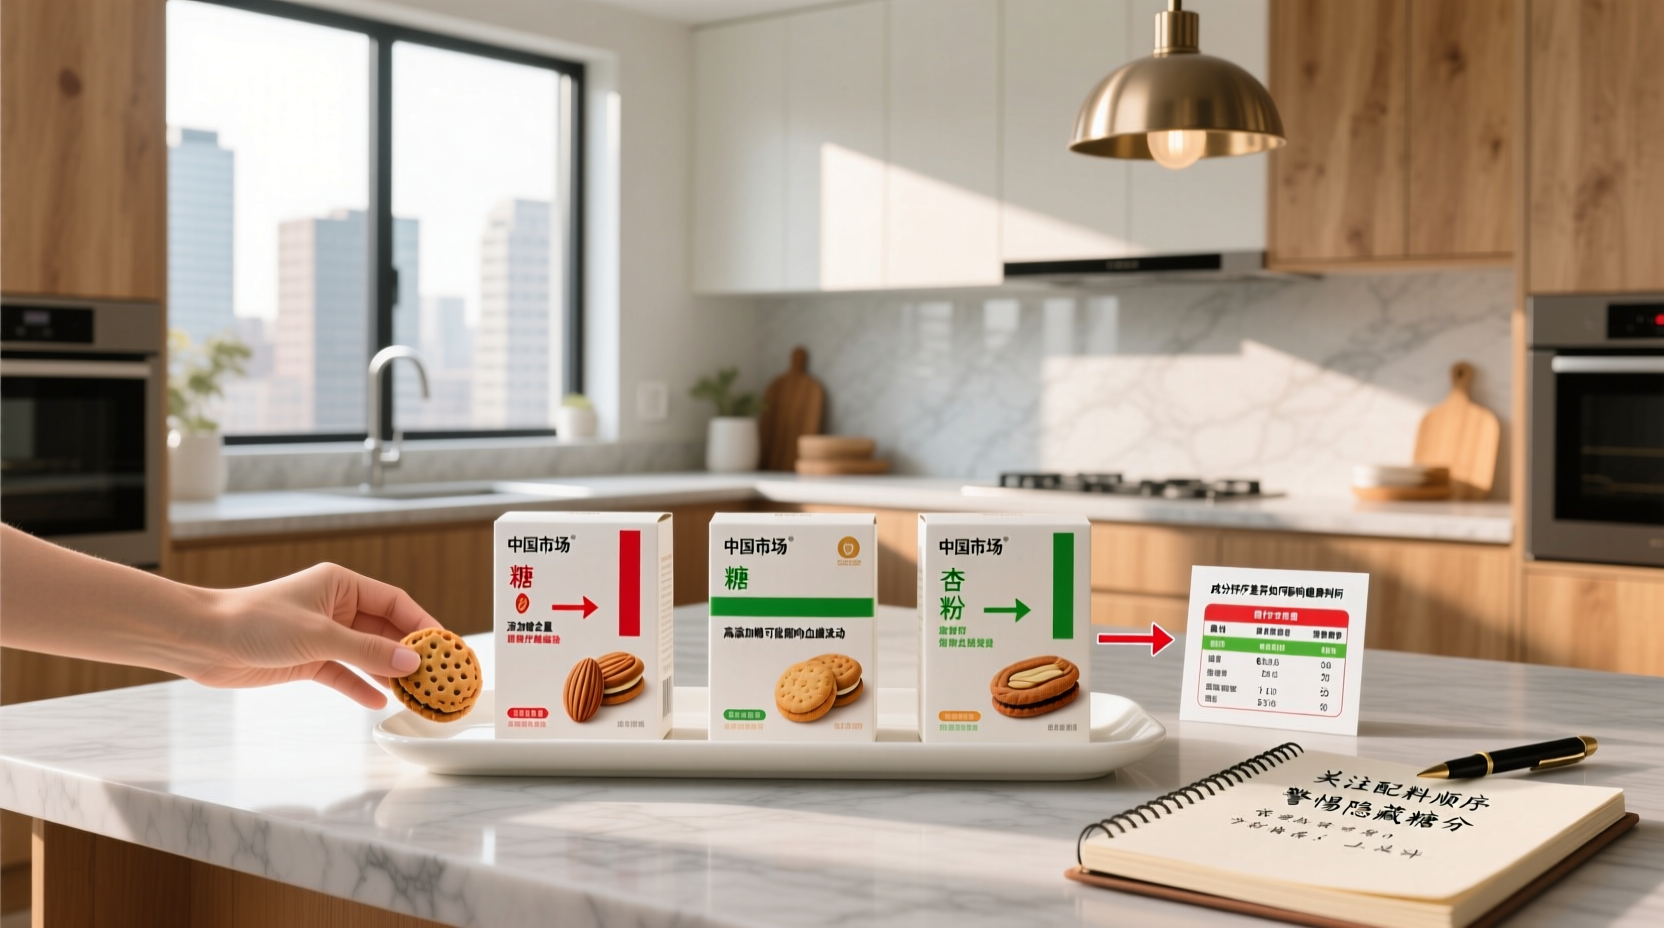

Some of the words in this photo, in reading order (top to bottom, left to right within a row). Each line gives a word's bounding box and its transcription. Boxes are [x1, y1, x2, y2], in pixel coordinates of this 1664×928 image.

[507, 536, 571, 554] 中国市场
[724, 537, 788, 556] 中国市场
[939, 537, 1003, 556] 中国市场
[509, 564, 534, 589] 糖
[724, 565, 749, 590] 糖
[1313, 770, 1490, 811] 关注配料顺序
[1283, 787, 1474, 832] 警惕隐藏糖分
